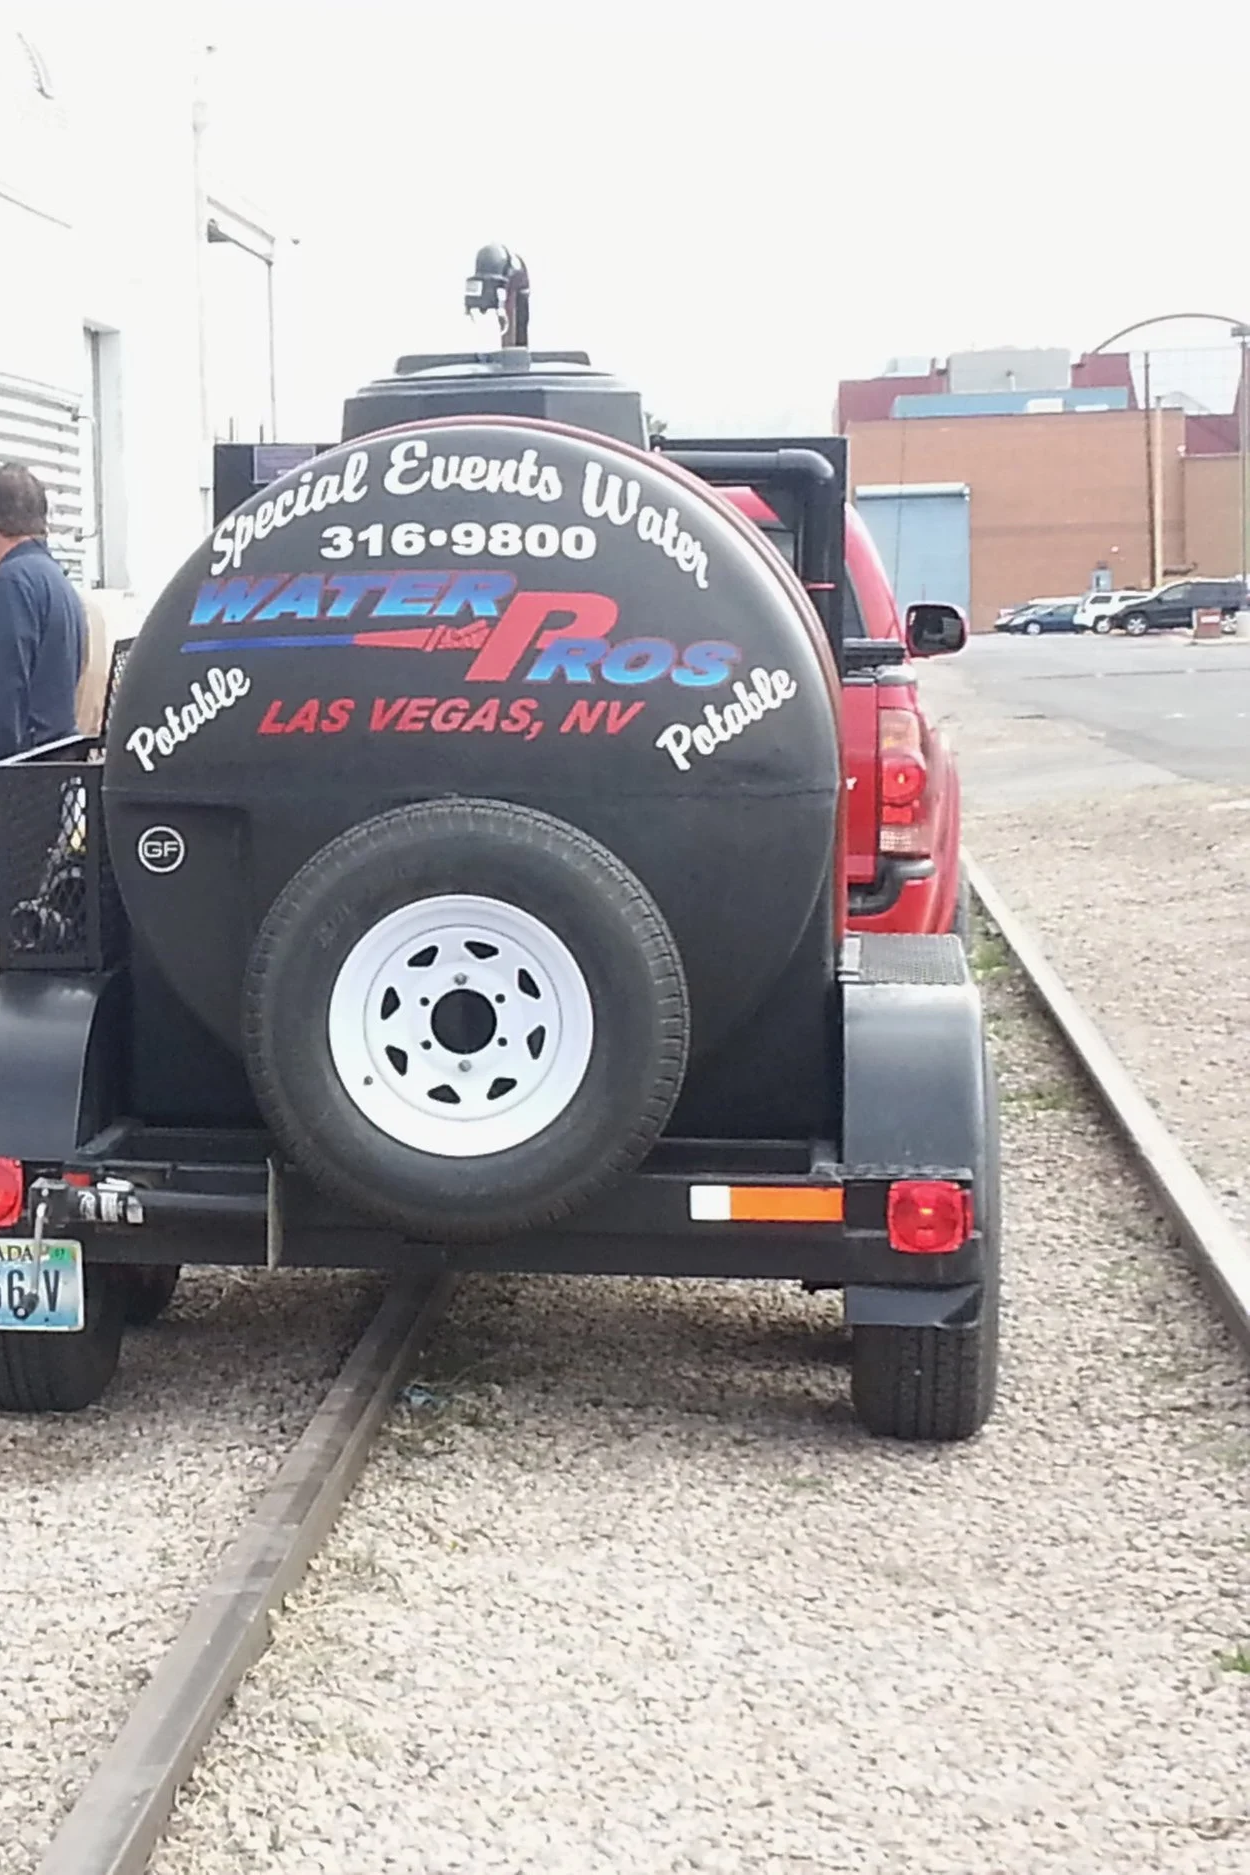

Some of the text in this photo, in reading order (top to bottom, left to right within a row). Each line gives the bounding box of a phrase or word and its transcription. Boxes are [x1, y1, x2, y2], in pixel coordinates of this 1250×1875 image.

[210, 440, 709, 589] Special Events Water
[188, 569, 516, 626] WATER
[125, 664, 252, 773] Potable
[258, 700, 645, 741] LAS VEGAS, NV
[655, 667, 798, 772] Potable
[143, 840, 179, 859] GF
[43, 1269, 61, 1312] V
